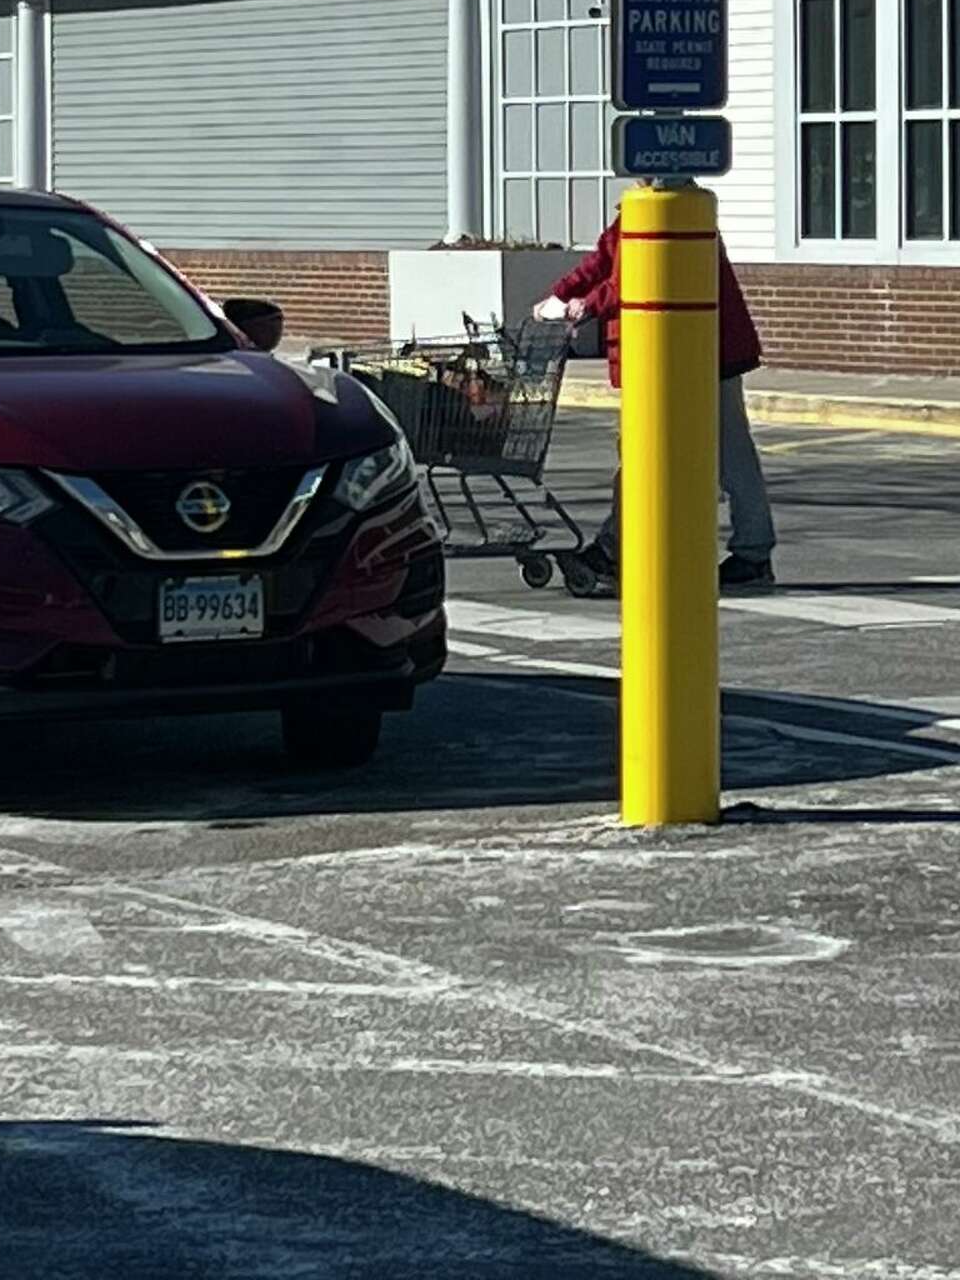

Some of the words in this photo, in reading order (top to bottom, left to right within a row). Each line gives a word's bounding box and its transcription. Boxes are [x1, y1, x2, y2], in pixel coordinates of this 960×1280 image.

[628, 9, 721, 34] PARKING
[655, 124, 696, 147] VAN
[632, 149, 721, 168] ACCESSIBLE
